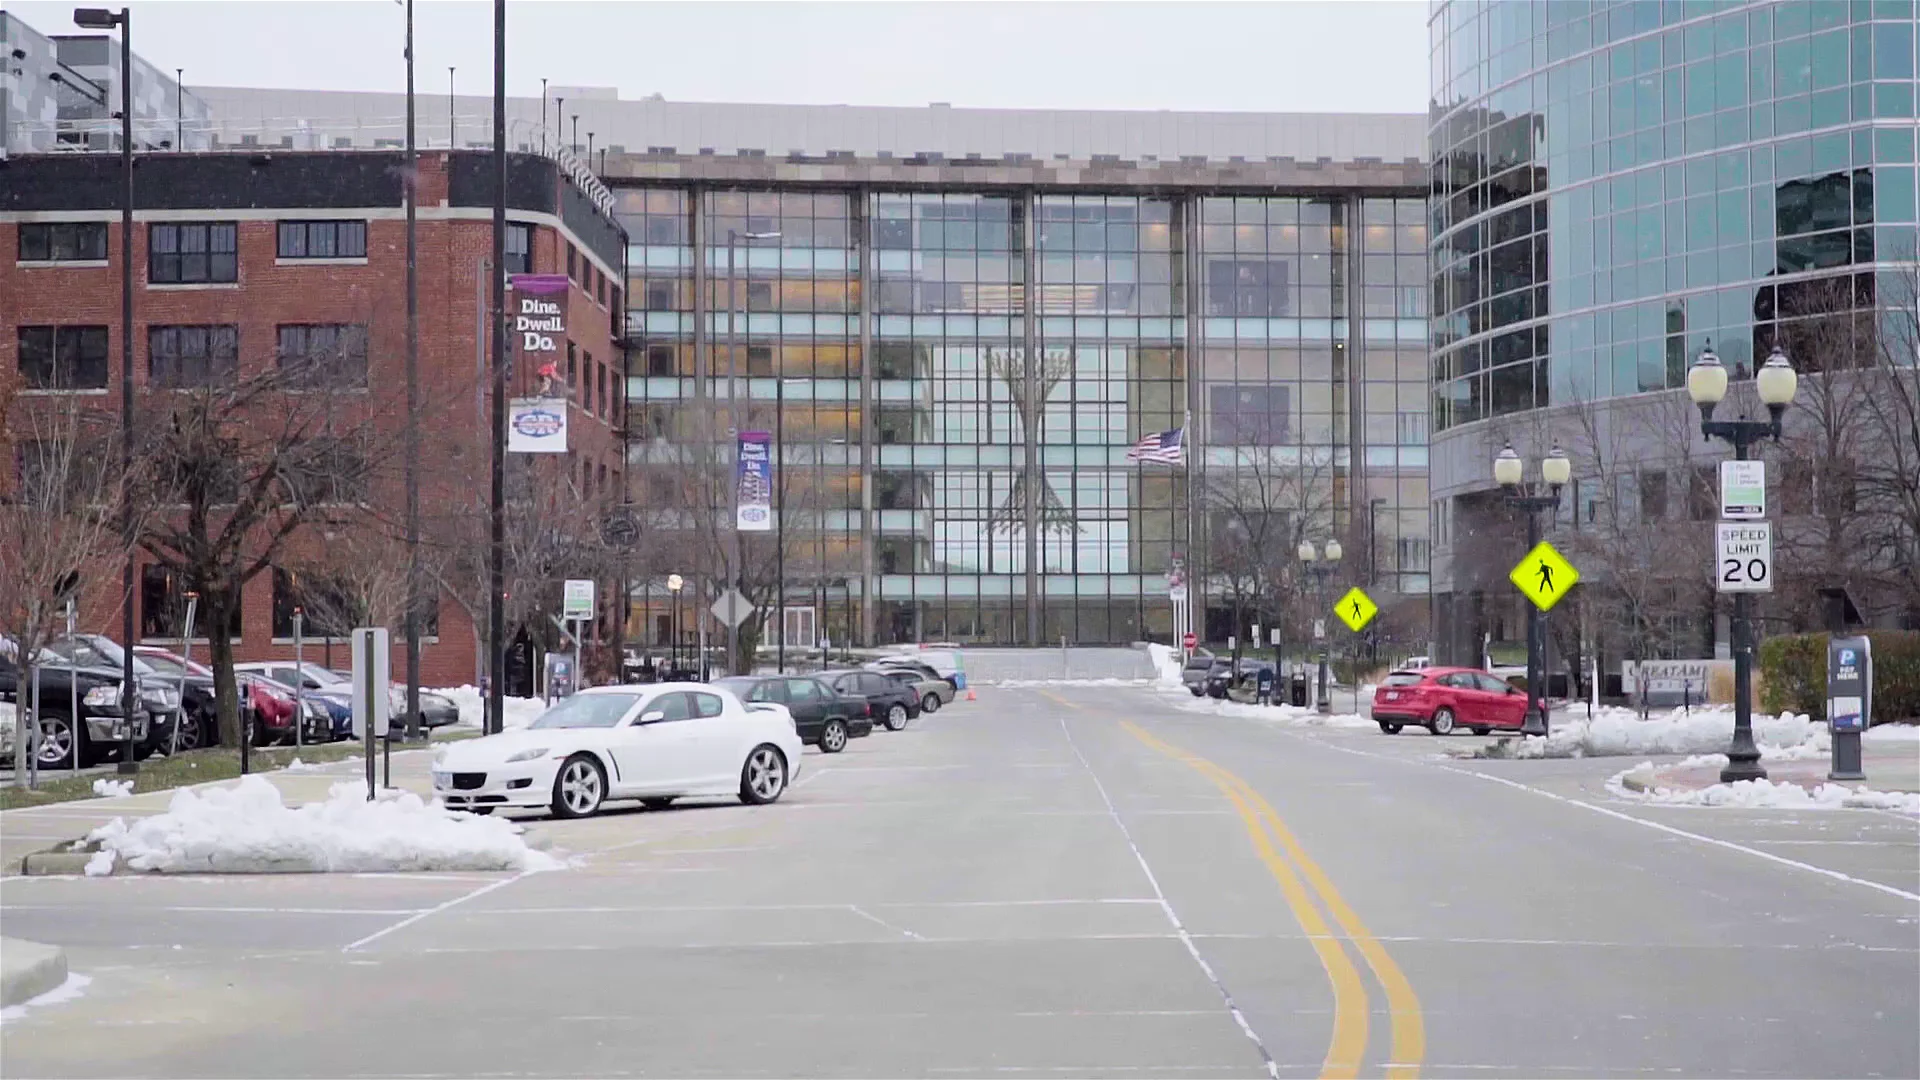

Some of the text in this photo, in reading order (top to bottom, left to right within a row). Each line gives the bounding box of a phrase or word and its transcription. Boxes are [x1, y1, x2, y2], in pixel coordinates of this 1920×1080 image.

[521, 299, 561, 314] Dine.
[516, 315, 565, 331] Dwell.
[523, 332, 557, 351] Do.
[1721, 529, 1767, 541] SPEED
[1726, 543, 1761, 555] LIMIT
[1723, 558, 1767, 582] 20
[1840, 648, 1855, 665] P
